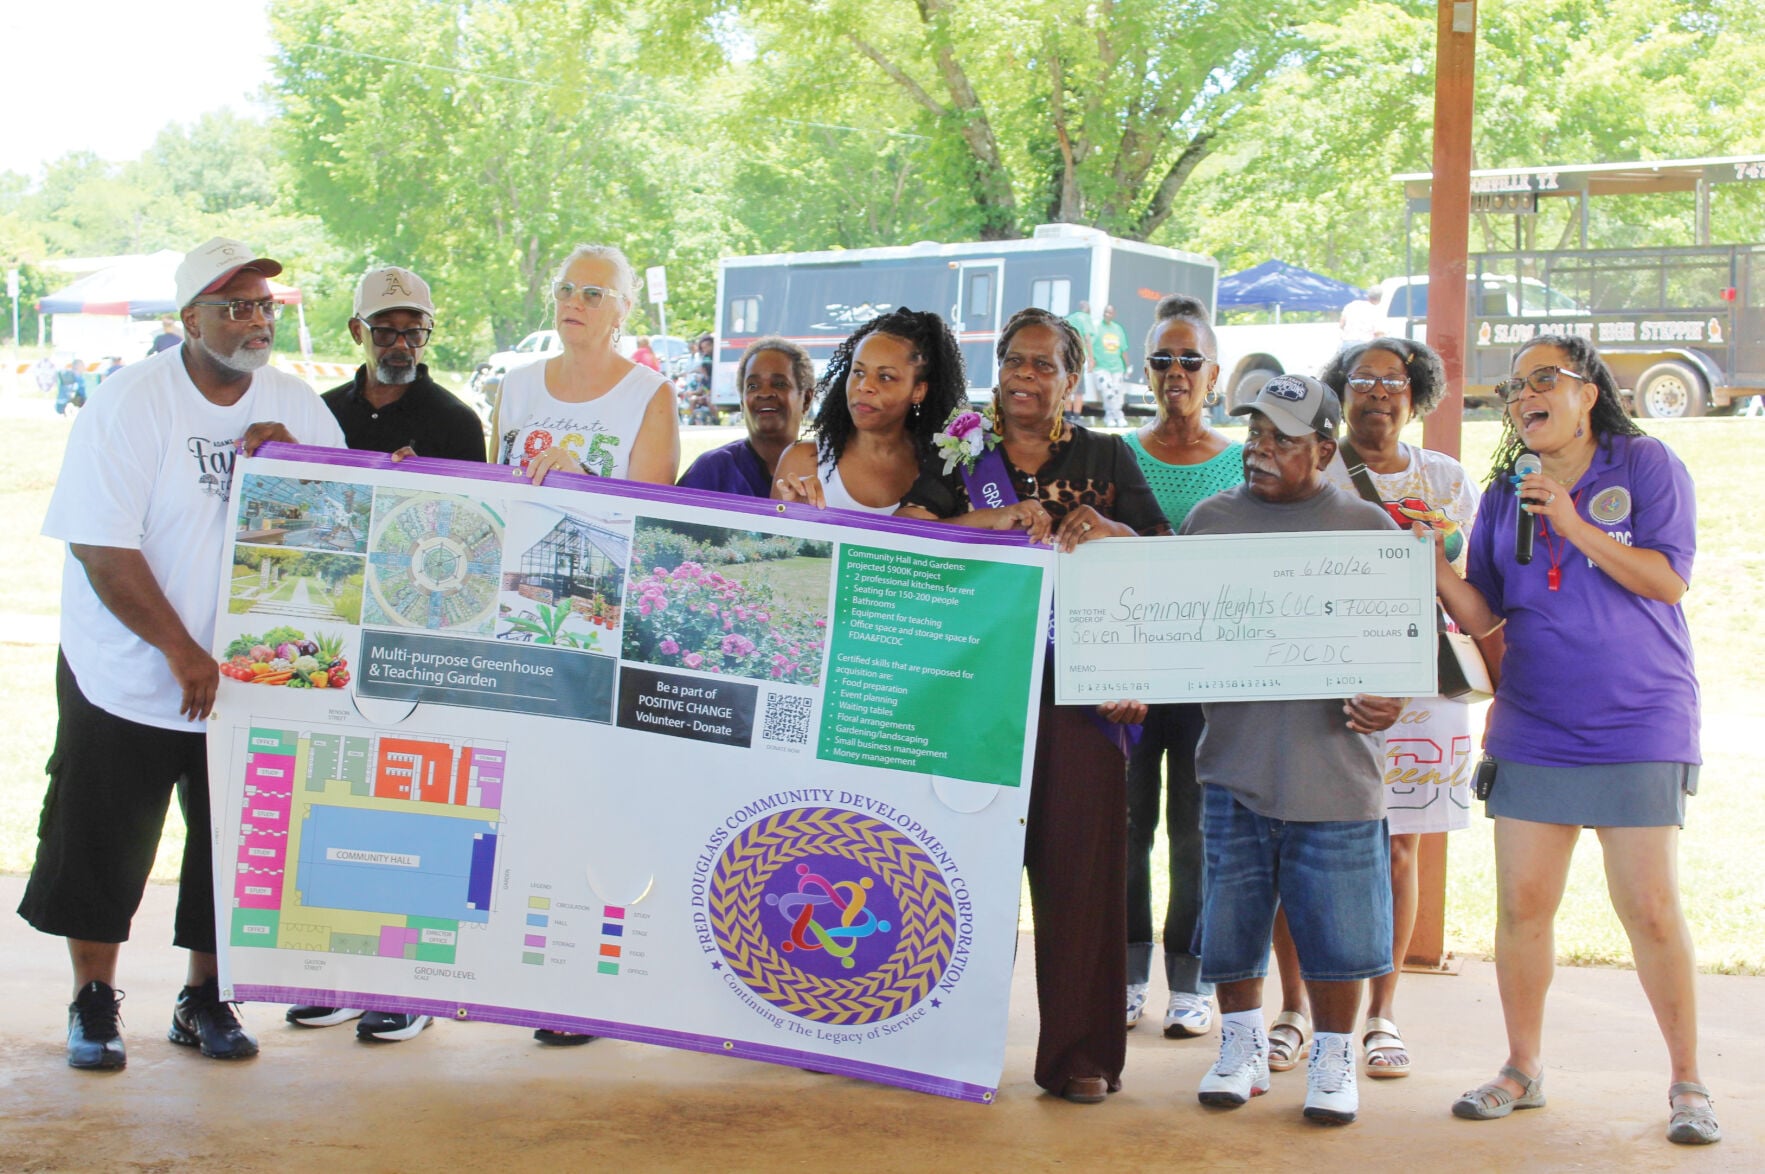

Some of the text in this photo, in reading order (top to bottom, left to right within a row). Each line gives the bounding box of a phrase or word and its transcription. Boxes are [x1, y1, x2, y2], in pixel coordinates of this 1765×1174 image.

[982, 482, 1005, 509] GRA
[847, 548, 966, 571] Community Hall and Gardens:
[1377, 548, 1411, 559] 1001
[846, 561, 941, 581] projected $900K project
[1273, 570, 1295, 578] DATE
[854, 573, 975, 596] 2 professional kitchens for rent
[852, 596, 896, 609] Bathrooms
[853, 584, 960, 606] Seating for 150-200 people
[851, 607, 943, 629] Equipment for teaching
[1092, 608, 1107, 616] THE
[1110, 586, 1210, 632] Seminary
[1213, 584, 1274, 624] Heights
[1325, 601, 1334, 615] $
[850, 619, 981, 645] Office space and storage space for
[1071, 624, 1120, 643] Seven
[1125, 623, 1203, 643] Thousand
[1216, 624, 1277, 641] Dollars
[1363, 629, 1402, 637] DOLLARS
[371, 646, 554, 677] Multi-purpose Greenhouse
[837, 653, 974, 680] Certified skills that are proposed for
[1069, 665, 1097, 673] MEMO
[368, 663, 497, 688] & Teaching Garden
[835, 665, 894, 680] acquisition are:
[657, 681, 718, 699] Be a part of
[842, 677, 908, 694] Food preparation
[638, 695, 733, 719] POSITIVE CHANGE
[840, 689, 898, 706] Event planning
[839, 701, 893, 716] Waiting tables
[635, 710, 685, 728] Volunteer
[693, 720, 733, 736] Donate
[837, 712, 915, 731] Floral arrangements
[835, 724, 929, 746] Gardening/landscaping
[833, 747, 916, 766] Money management
[834, 735, 948, 759] Small business management
[336, 850, 412, 865] COMMUNITY HALL
[691, 789, 974, 994] FRED DOUGLASS COMMUNITY DEVELOPMENT CORPORATION
[414, 966, 477, 981] GROUND LEVEL
[723, 972, 927, 1045] Continuing The Legacy of Service
